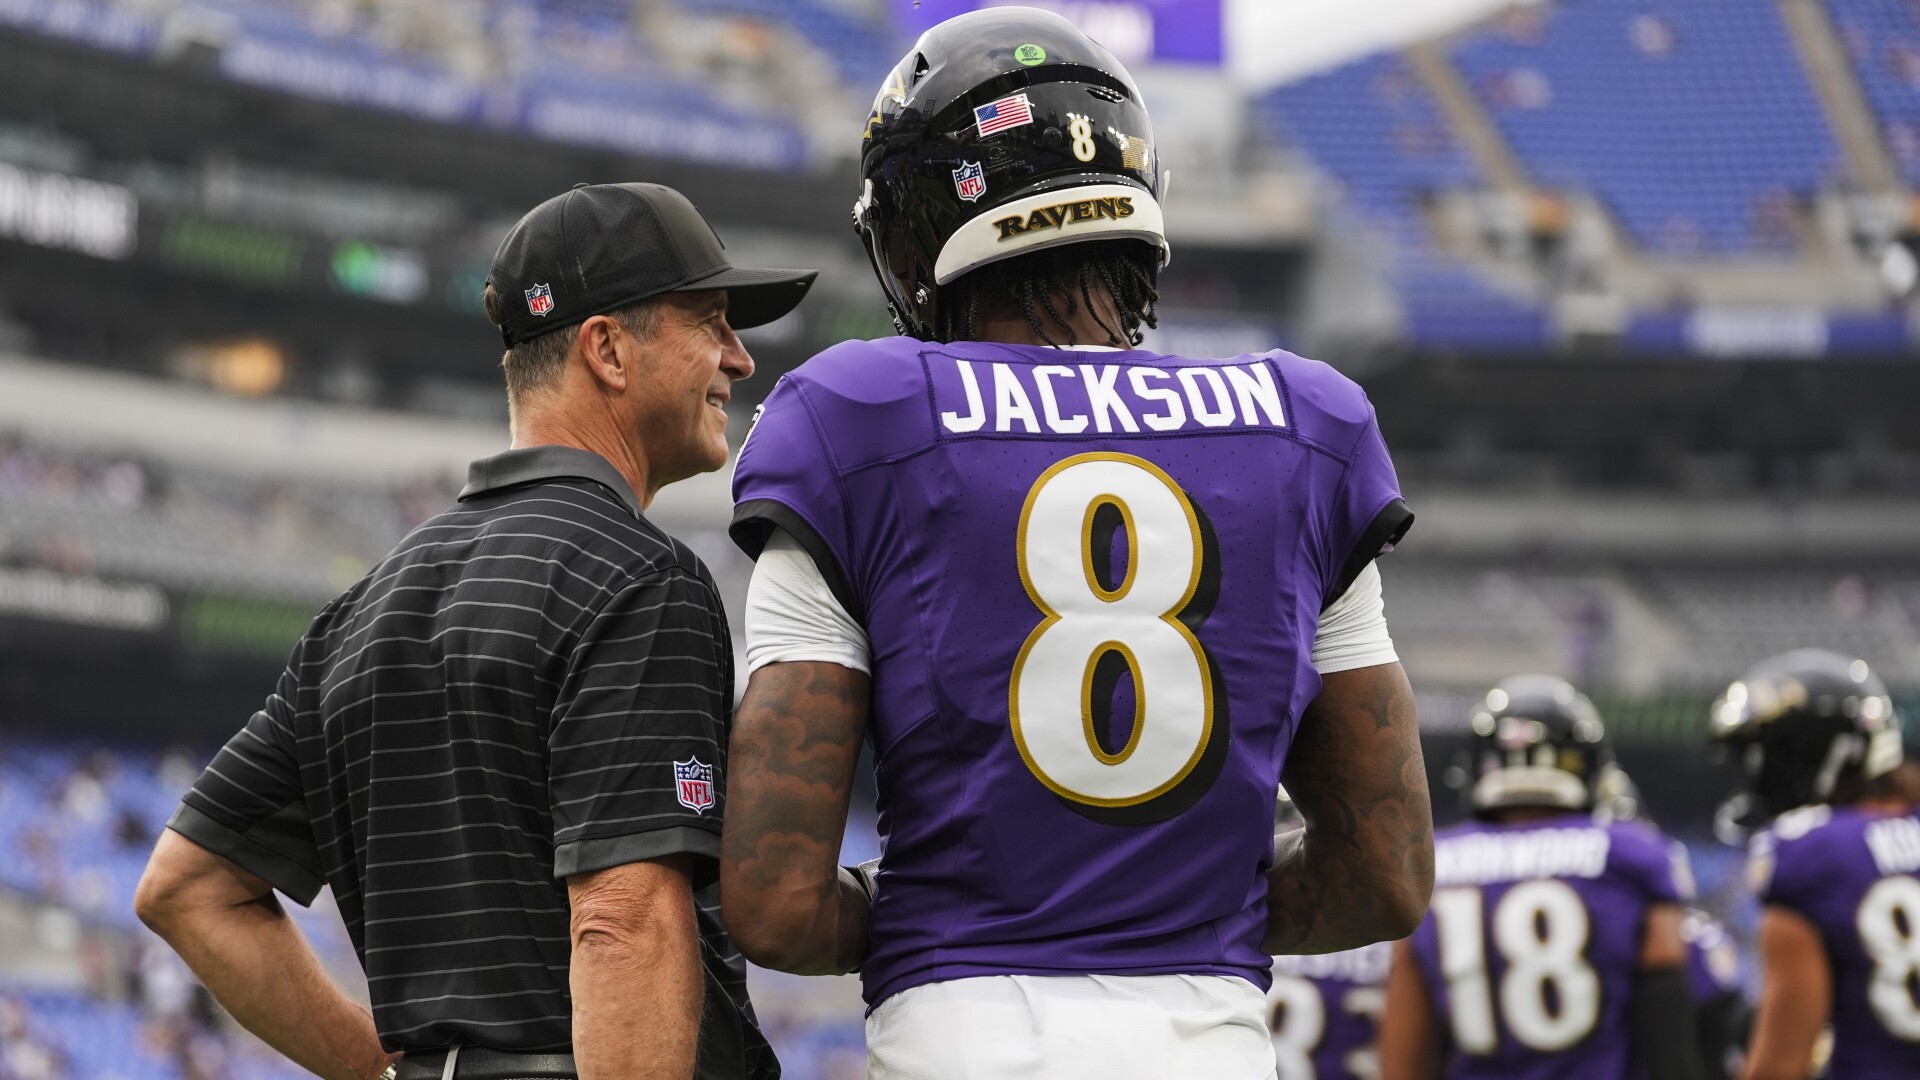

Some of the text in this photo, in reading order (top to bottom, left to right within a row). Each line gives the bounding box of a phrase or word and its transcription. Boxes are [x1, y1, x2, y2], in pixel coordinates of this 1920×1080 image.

[1069, 118, 1096, 162] 8
[960, 177, 982, 196] NFL
[992, 197, 1135, 242] RAVENS
[531, 295, 551, 312] NFL
[941, 359, 1287, 434] JACKSON
[1009, 451, 1215, 808] 8
[681, 781, 712, 805] NFL
[1433, 876, 1601, 1055] 18
